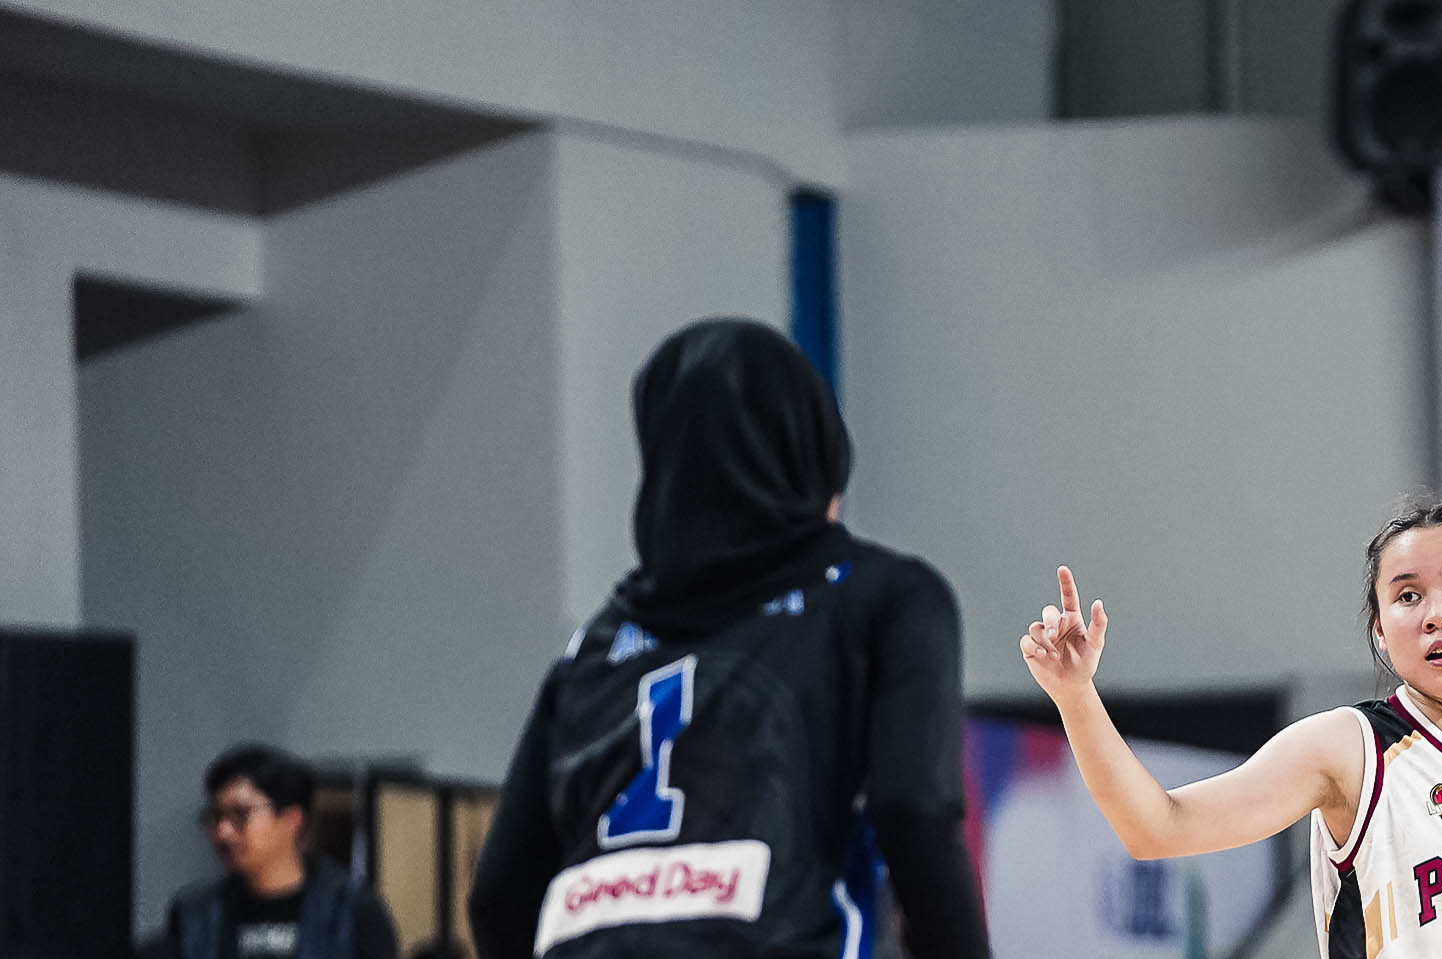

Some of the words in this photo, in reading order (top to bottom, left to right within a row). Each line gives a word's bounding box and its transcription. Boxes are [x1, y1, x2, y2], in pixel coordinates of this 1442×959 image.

[597, 653, 698, 846] 1
[564, 863, 661, 914] Good
[664, 860, 741, 905] Day
